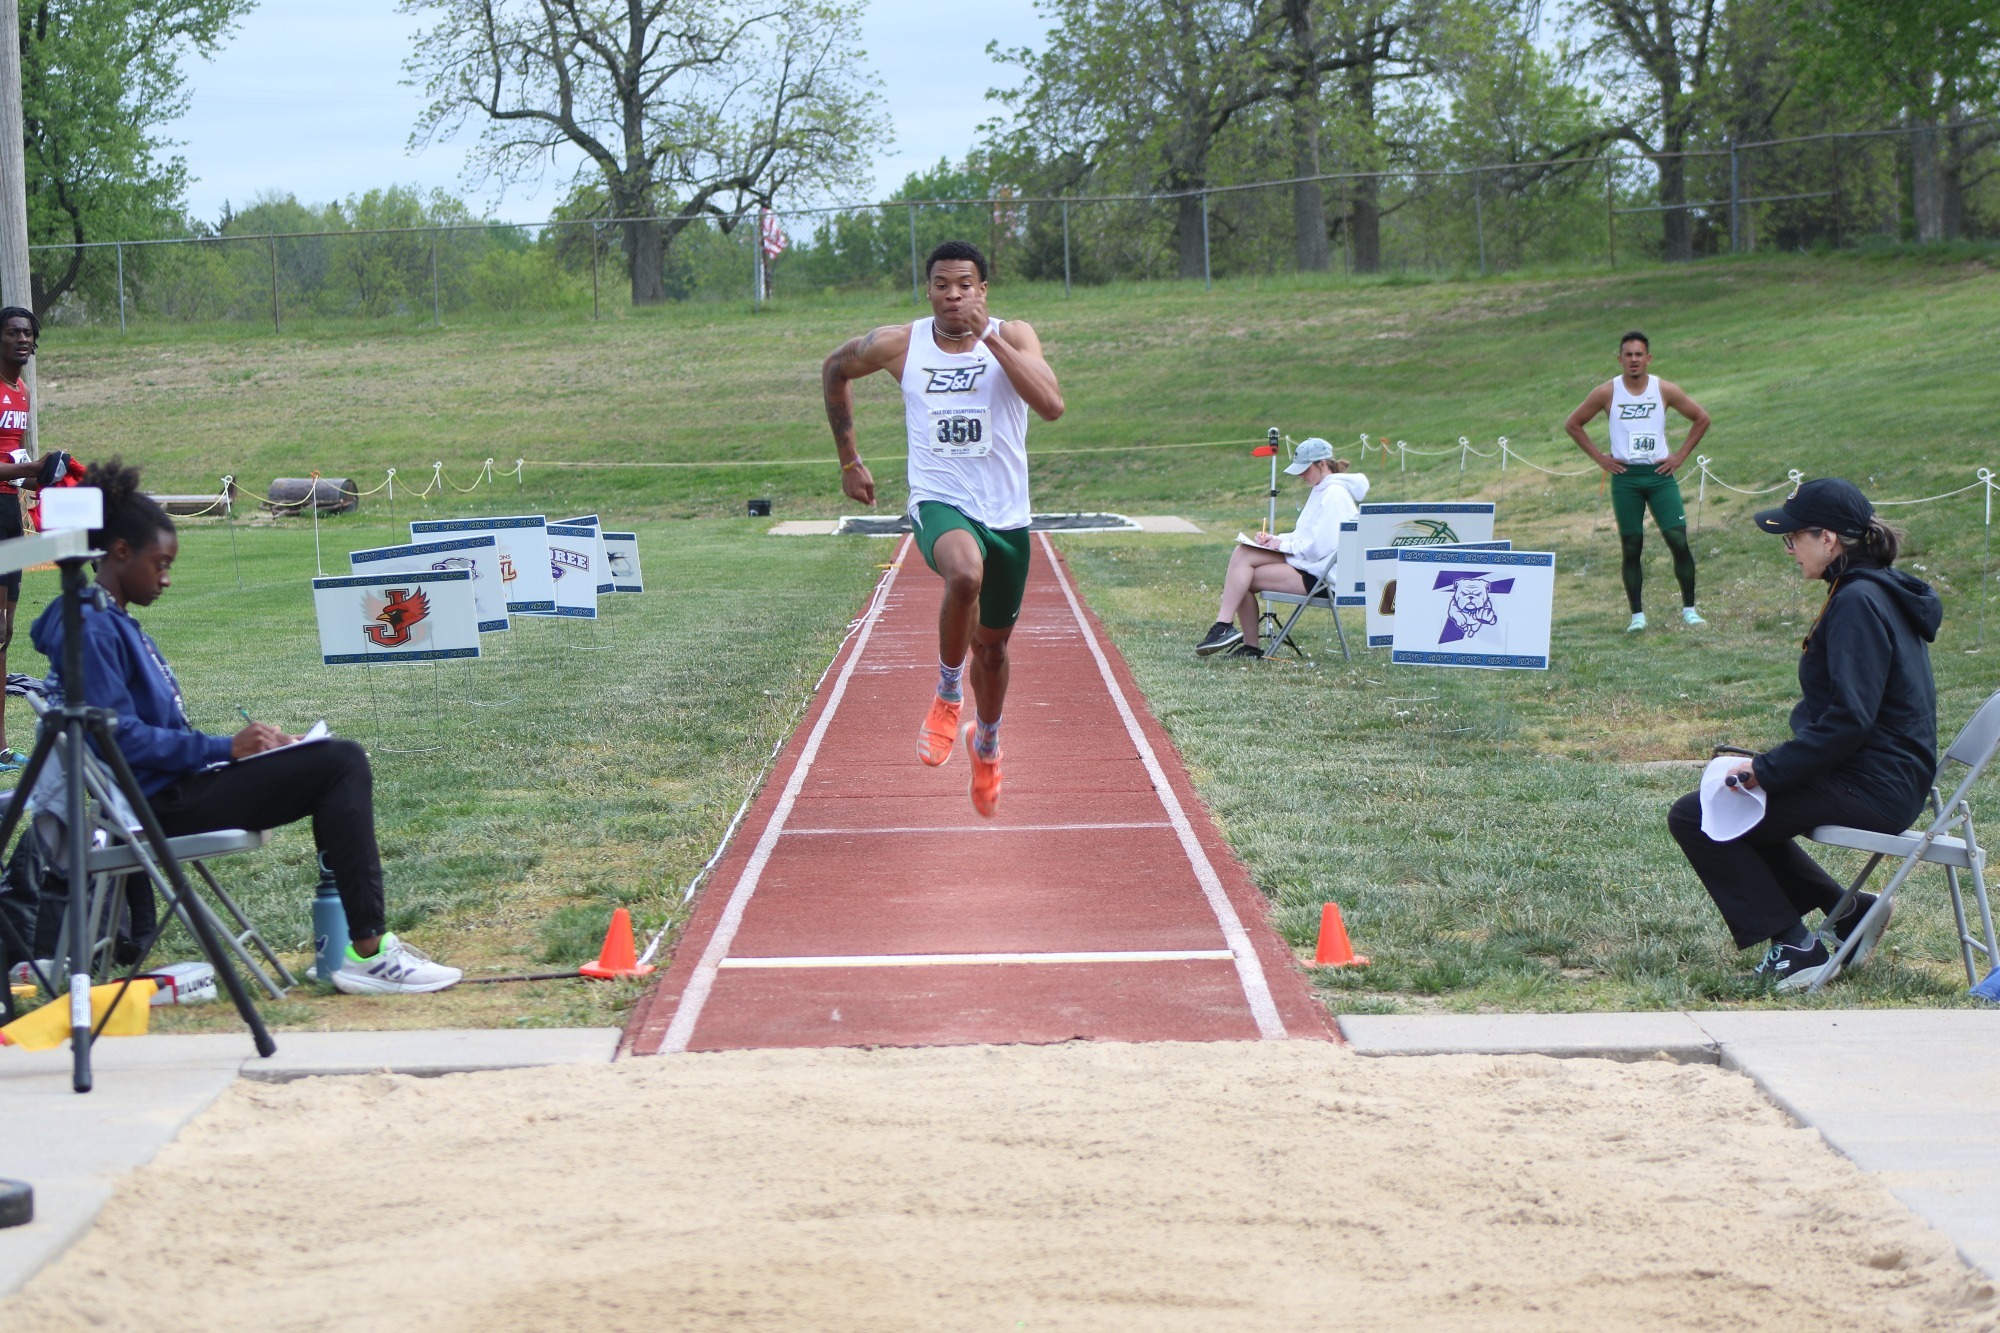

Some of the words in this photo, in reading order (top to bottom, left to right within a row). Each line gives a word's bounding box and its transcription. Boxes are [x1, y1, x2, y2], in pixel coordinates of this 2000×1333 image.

[922, 364, 987, 393] S&T
[1617, 403, 1657, 419] S&T
[937, 418, 982, 443] 350
[1633, 438, 1655, 451] 340
[1392, 537, 1444, 546] MISSOURI
